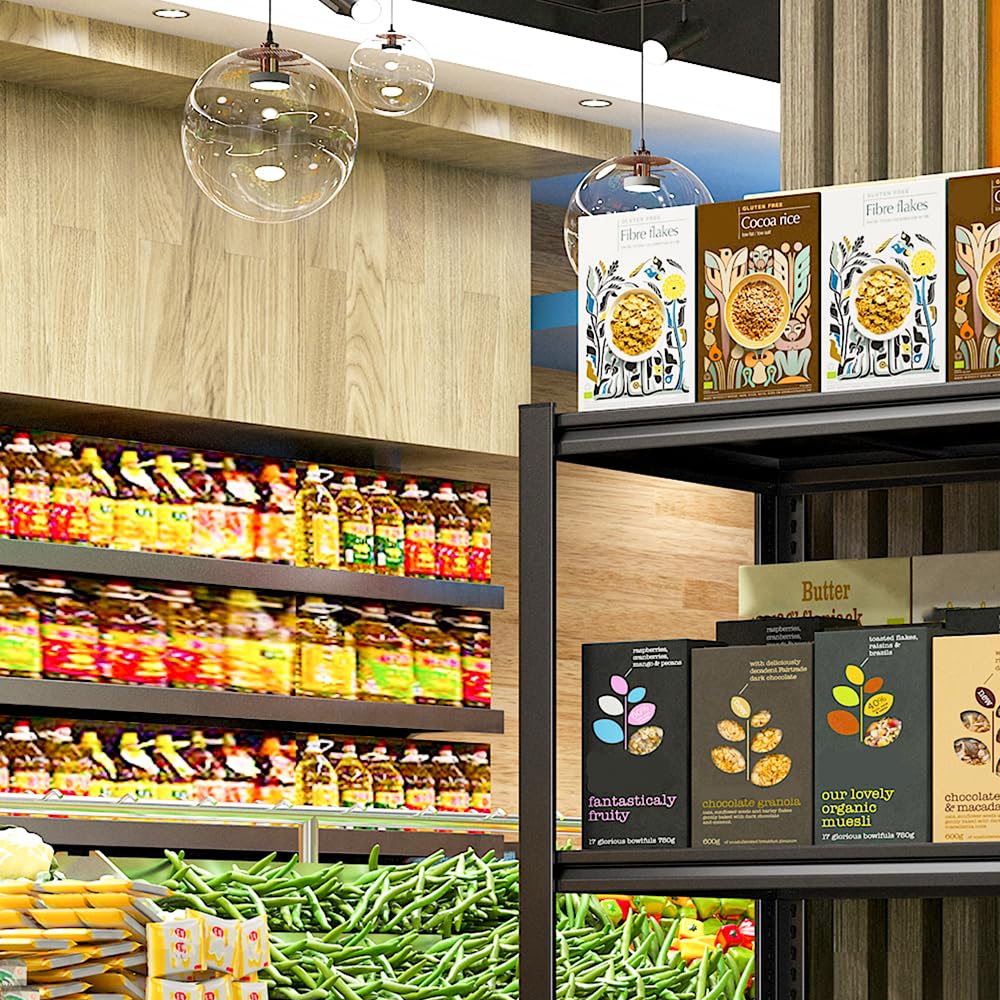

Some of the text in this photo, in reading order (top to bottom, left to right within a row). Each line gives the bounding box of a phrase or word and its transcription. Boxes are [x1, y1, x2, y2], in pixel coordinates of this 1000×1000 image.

[742, 203, 765, 211] GLUTEN
[866, 199, 928, 216] Fibre flakes
[741, 212, 801, 230] Cocoa rice
[620, 225, 679, 241] Fibre flakes
[802, 581, 850, 602] Butter
[977, 689, 993, 706] new
[588, 794, 677, 808] fantasticaly
[822, 788, 894, 801] our lovely
[944, 792, 1000, 801] chocolate
[703, 798, 801, 808] chocolate granola
[822, 802, 877, 816] organic
[944, 803, 955, 812] &
[588, 810, 630, 823] fruity
[821, 815, 872, 828] muesli
